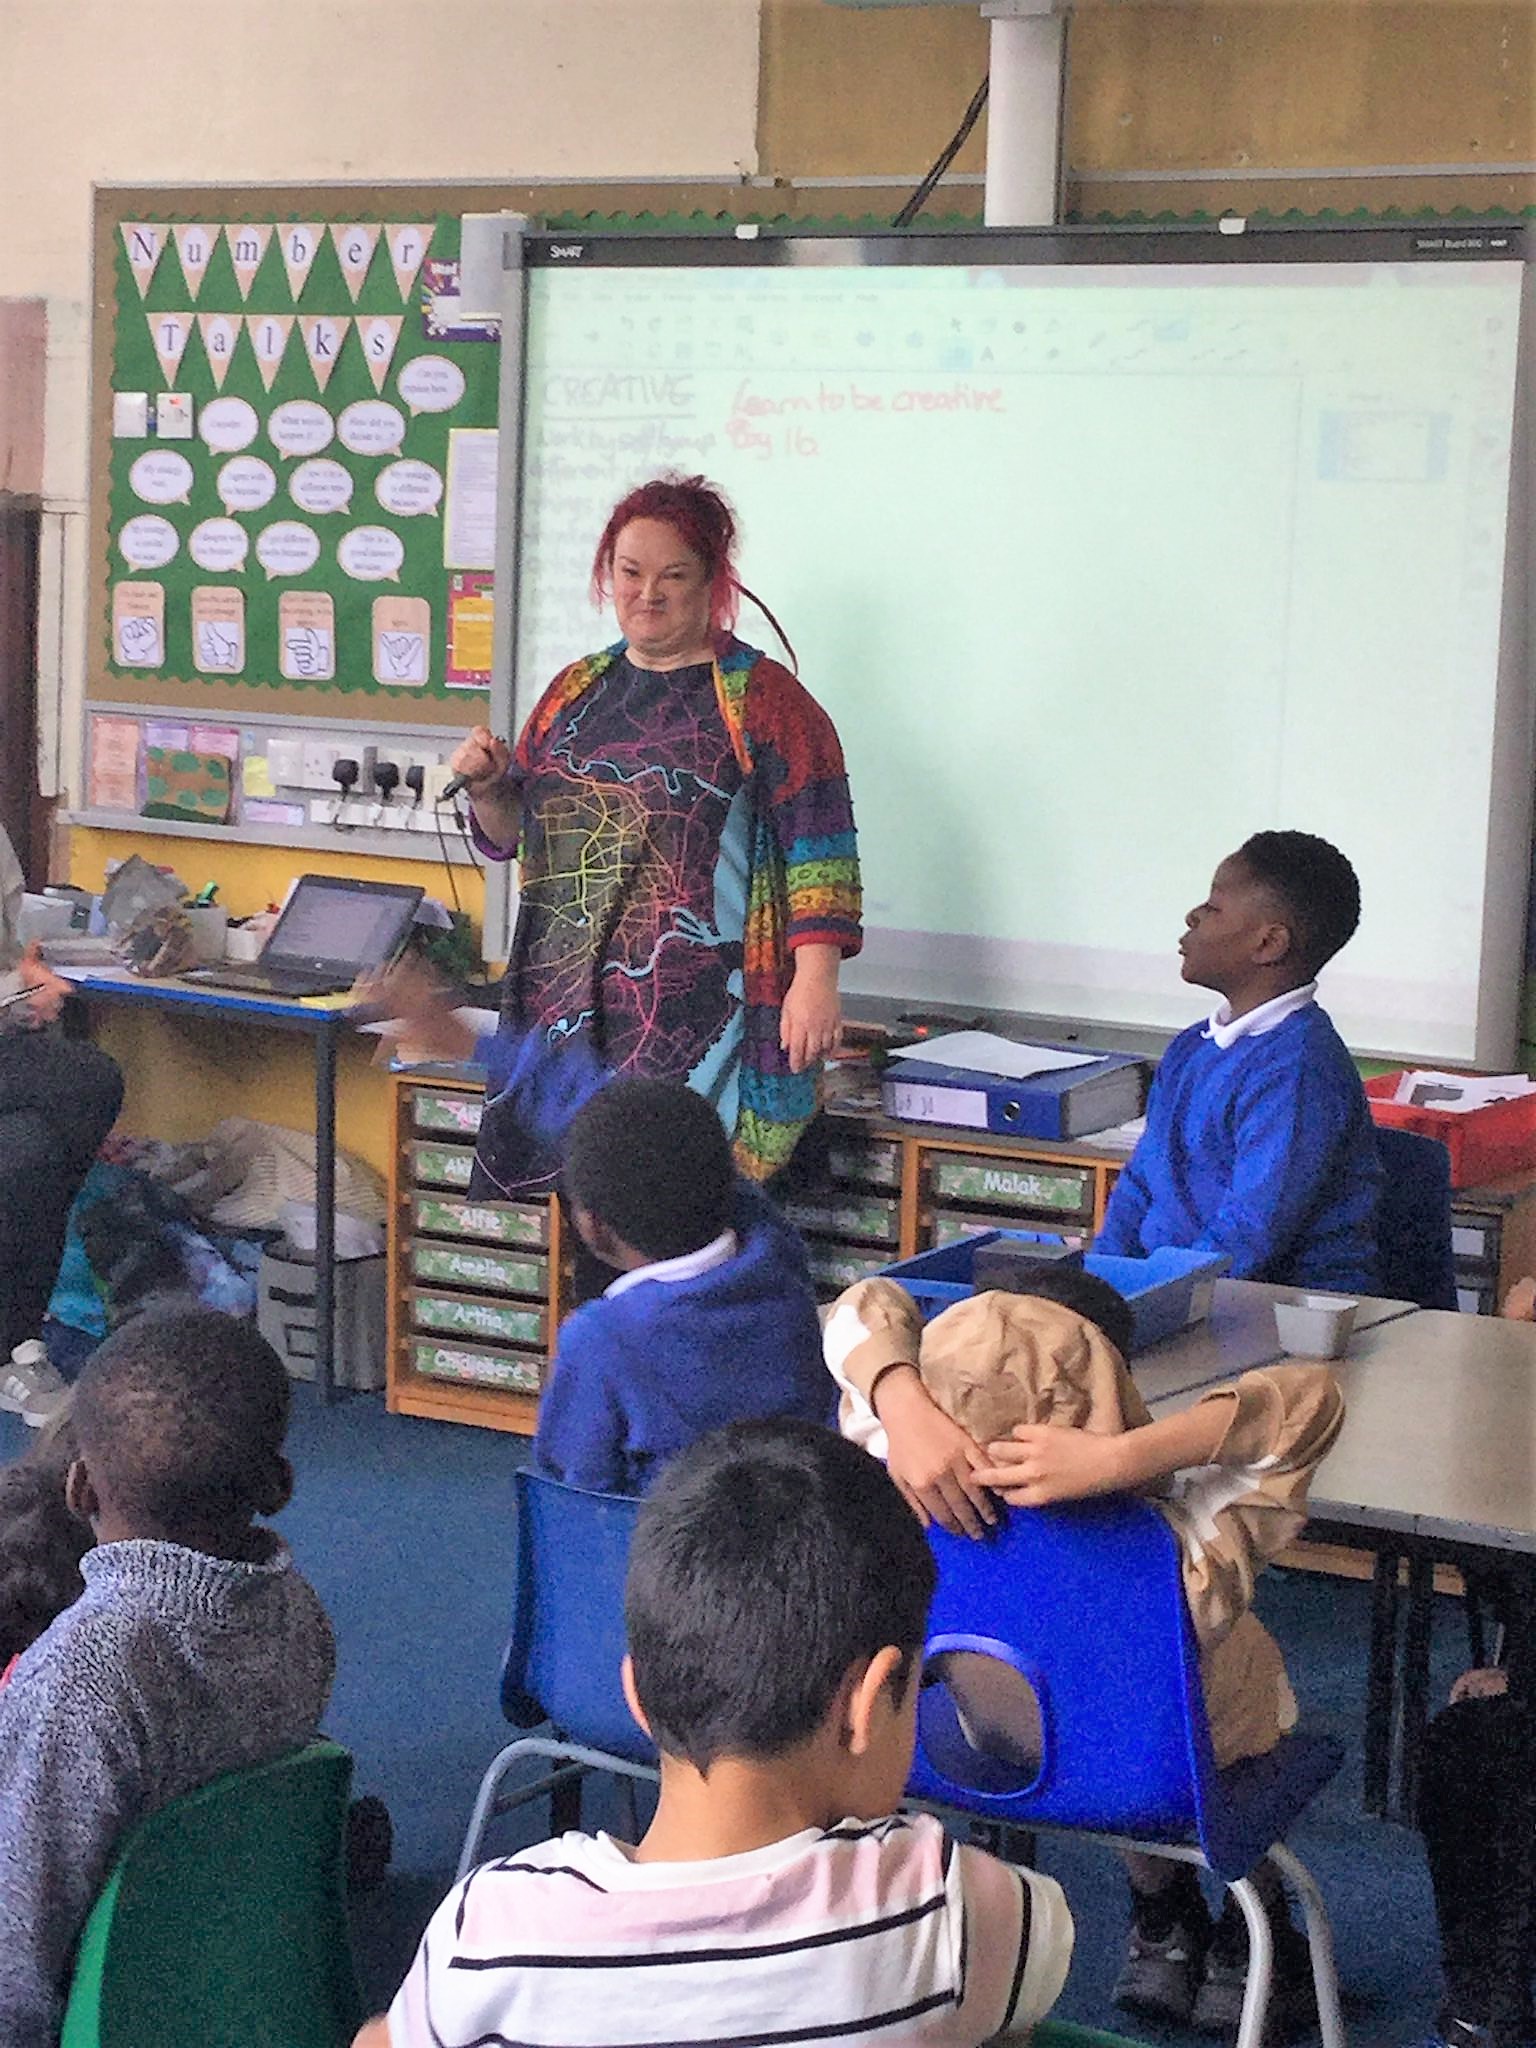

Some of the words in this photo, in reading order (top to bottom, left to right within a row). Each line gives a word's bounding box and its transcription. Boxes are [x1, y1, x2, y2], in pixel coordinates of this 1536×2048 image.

[817, 380, 845, 413] to
[849, 383, 885, 413] be
[983, 1170, 1041, 1197] Malak
